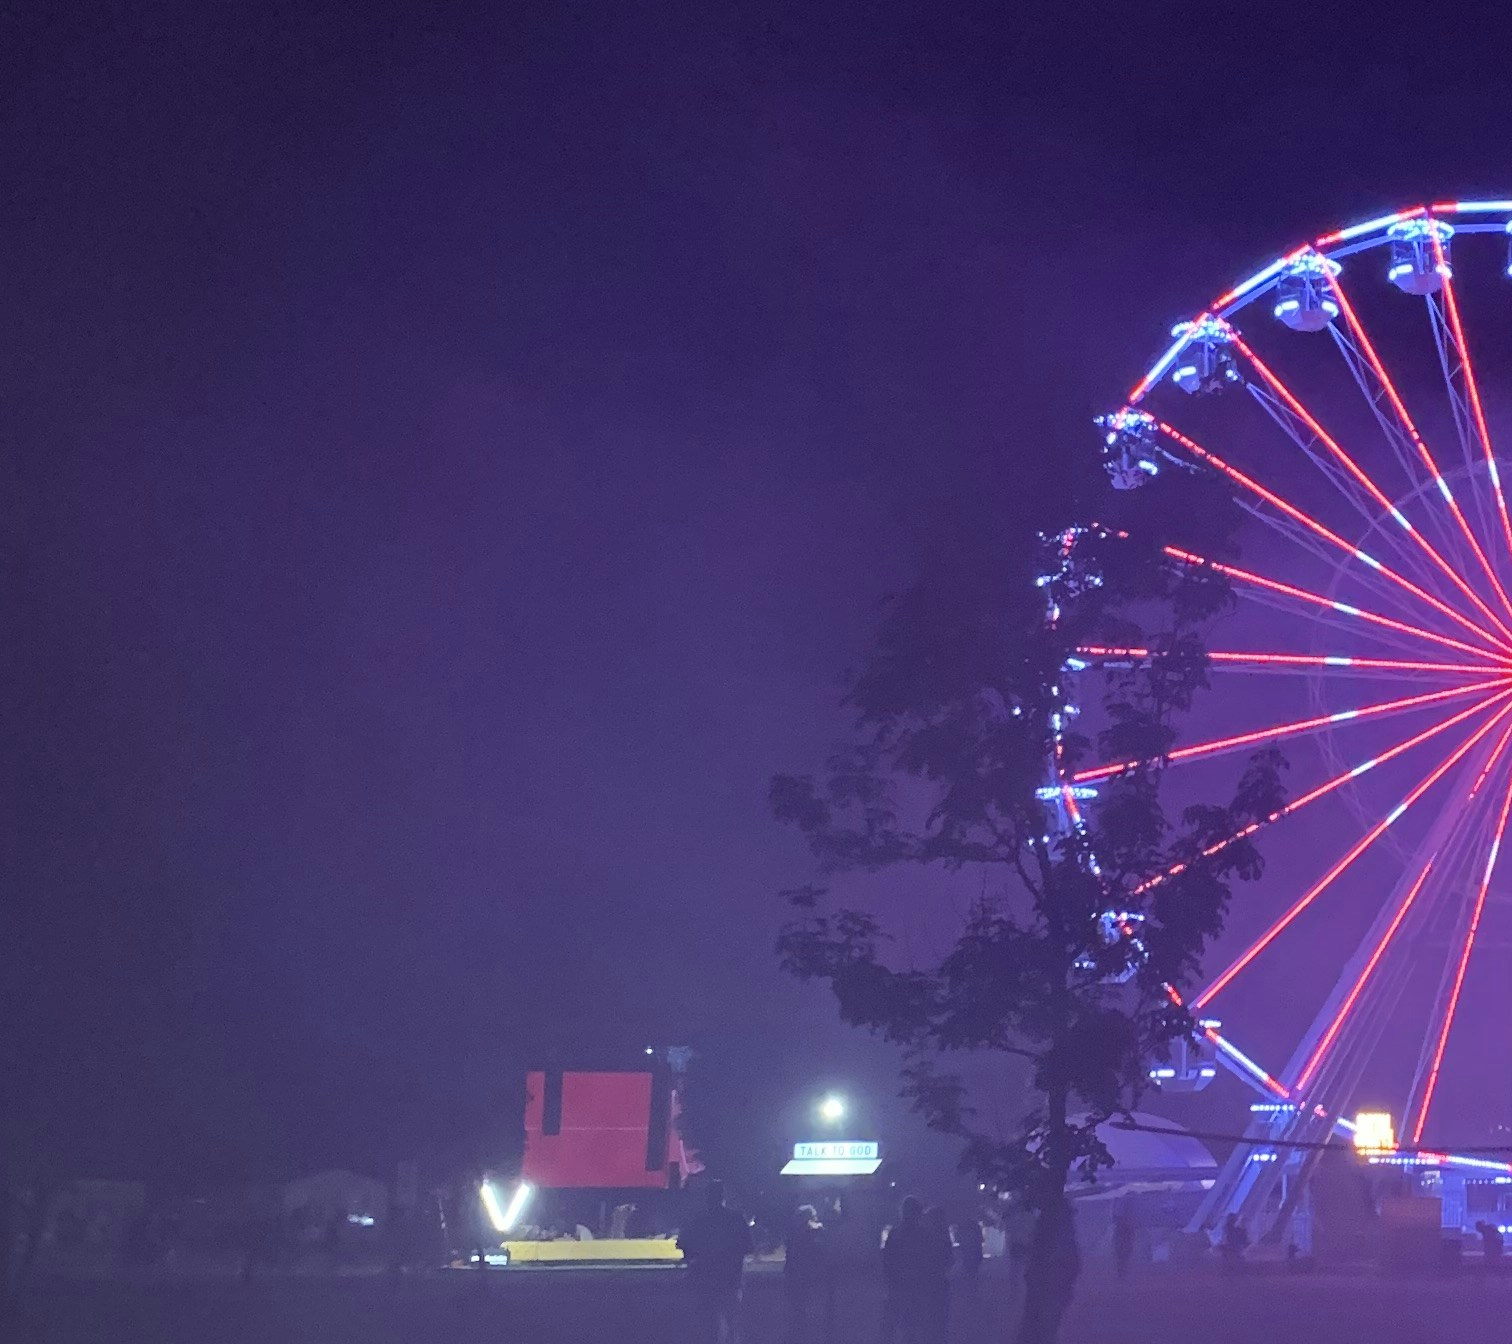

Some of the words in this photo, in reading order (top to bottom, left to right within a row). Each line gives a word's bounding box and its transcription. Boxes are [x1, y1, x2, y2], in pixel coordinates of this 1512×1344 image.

[800, 1146, 827, 1157] TALK
[832, 1146, 845, 1156] TO
[849, 1145, 872, 1156] GOD
